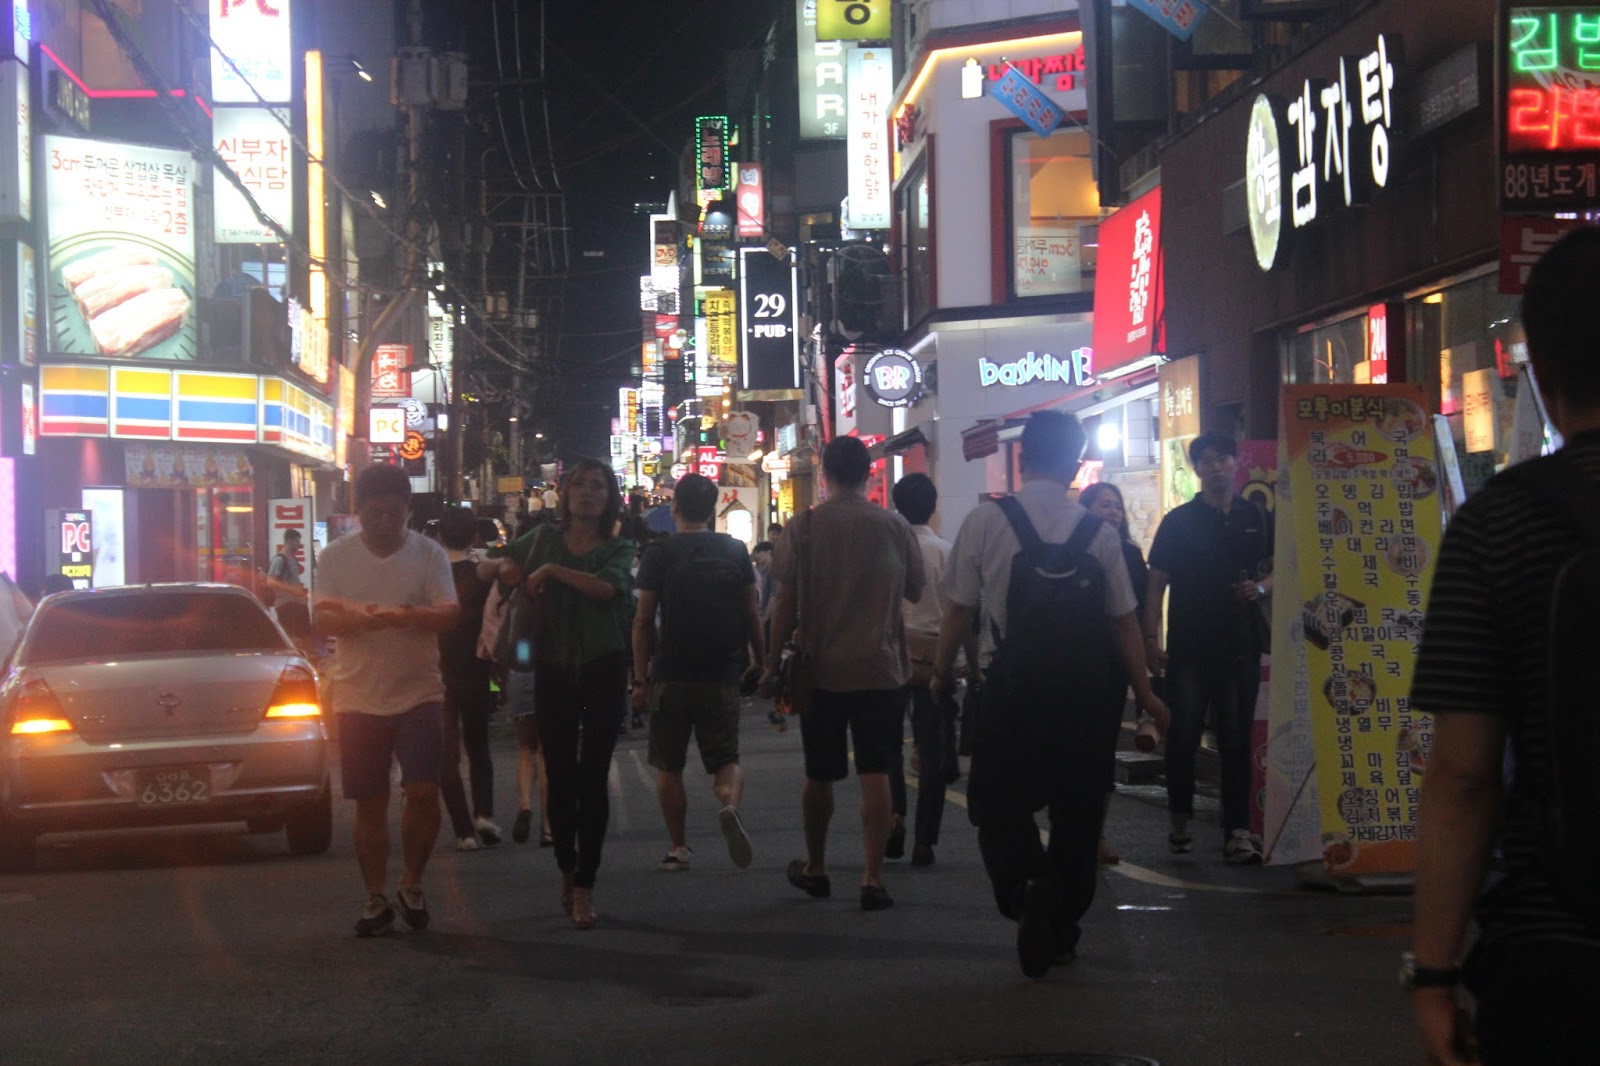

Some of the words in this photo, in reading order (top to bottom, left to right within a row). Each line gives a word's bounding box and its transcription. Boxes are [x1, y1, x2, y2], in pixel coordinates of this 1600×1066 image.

[824, 123, 839, 134] 3F
[1288, 34, 1393, 227] 감자탕
[217, 138, 288, 163] 신부자
[860, 91, 881, 200] 내가찜한닭
[701, 129, 722, 185] 노래방
[230, 166, 288, 191] 식당
[1505, 162, 1600, 199] 88년도개
[656, 249, 677, 258] DVD
[754, 294, 785, 318] 29
[754, 324, 787, 338] PUB
[874, 365, 910, 390] BR
[978, 351, 1070, 387] baskin
[377, 420, 400, 433] PC
[1315, 483, 1413, 501] 오뎅김밥
[1317, 501, 1414, 517] 주먹밥
[1317, 519, 1416, 535] 베이컨라면
[61, 522, 90, 553] PC
[1319, 537, 1416, 553] 부대라면
[1320, 554, 1418, 570] 수제비
[1322, 572, 1420, 589] 칼국수
[1326, 608, 1424, 625] 비빔국수
[1328, 625, 1423, 643] 김치말이국수
[1331, 661, 1401, 679] 잔치국
[1334, 697, 1411, 715] 열무비빔
[1341, 770, 1411, 787] 제육덮
[141, 780, 207, 803] 6362
[1342, 787, 1420, 806] 오징어덮
[1345, 806, 1420, 824] 김치볶음
[1347, 825, 1417, 842] 카레김치볶
